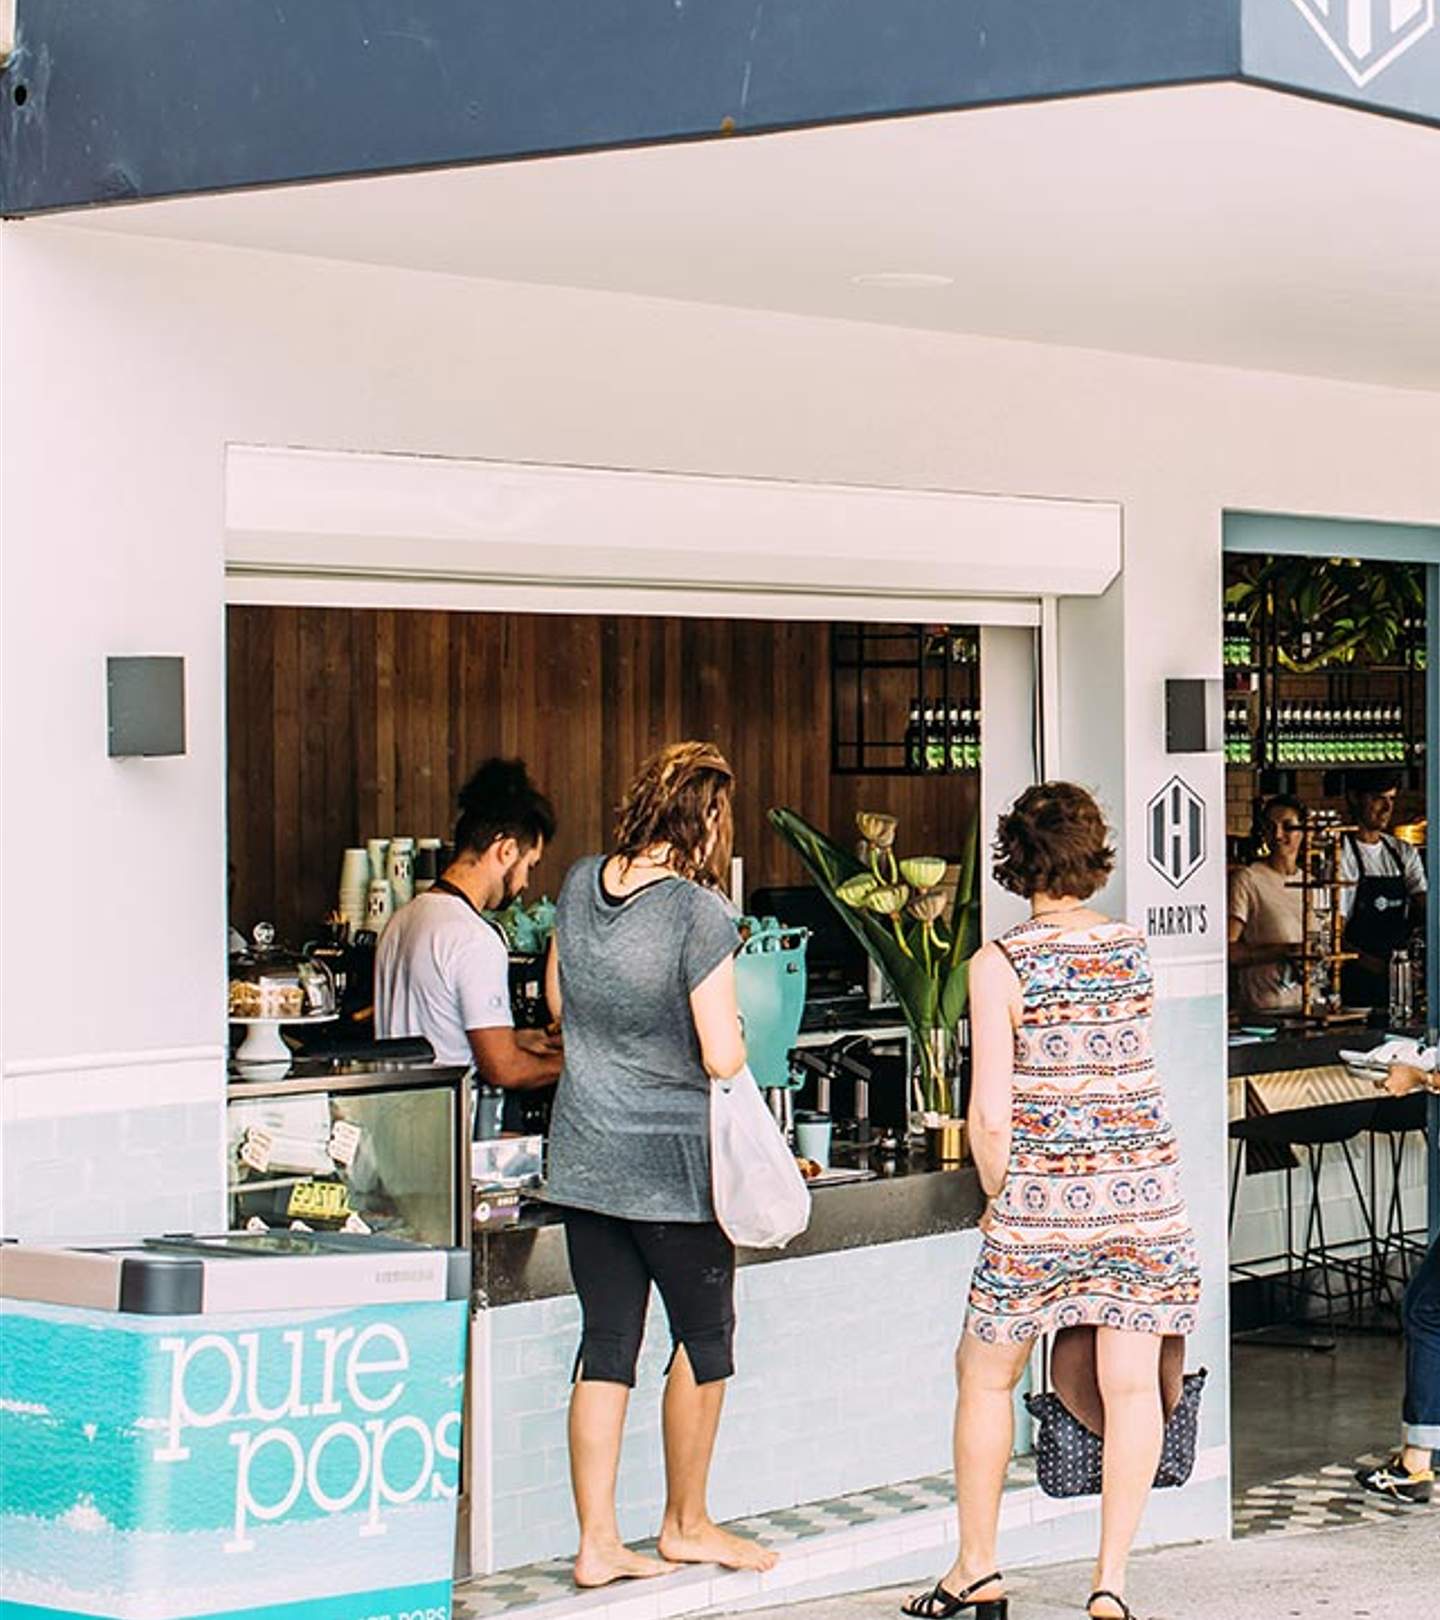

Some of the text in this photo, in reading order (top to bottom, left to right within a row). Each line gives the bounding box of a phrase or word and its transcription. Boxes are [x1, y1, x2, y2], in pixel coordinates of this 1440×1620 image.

[1148, 904, 1207, 936] HARRY'S
[153, 1323, 411, 1462] pure
[221, 1411, 462, 1553] pops
